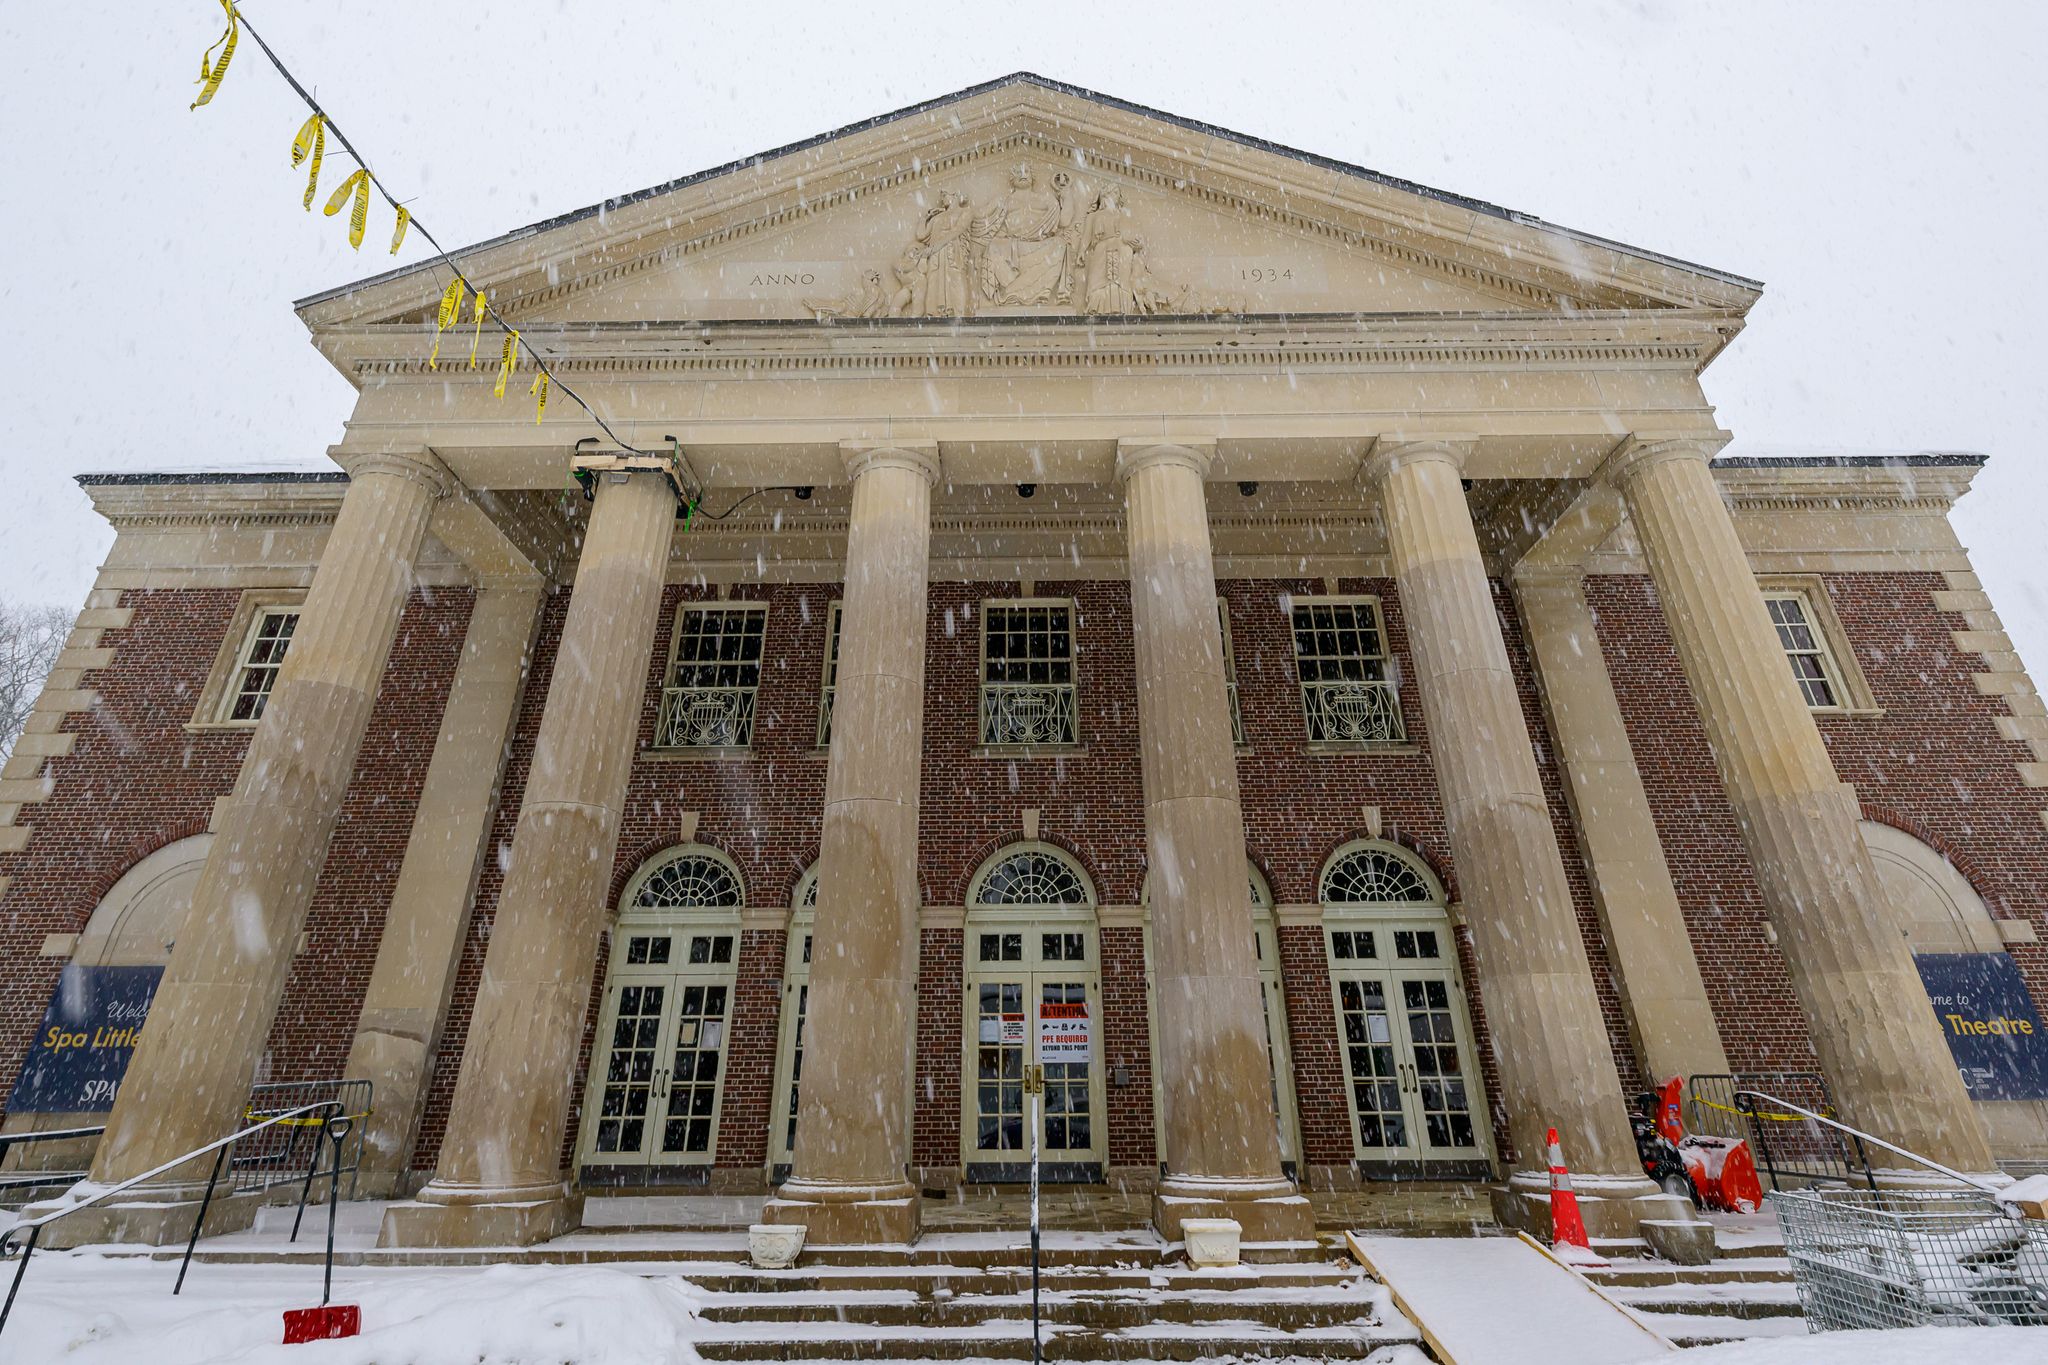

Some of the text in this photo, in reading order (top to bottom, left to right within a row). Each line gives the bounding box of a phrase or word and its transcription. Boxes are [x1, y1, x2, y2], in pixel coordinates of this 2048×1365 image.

[750, 273, 814, 286] ANNO
[1241, 268, 1294, 283] 1934
[1956, 992, 1969, 1005] to
[1042, 1006, 1088, 1017] ATTENTION
[1945, 1014, 2033, 1036] Theatre
[43, 1026, 88, 1054] Spa
[1042, 1035, 1088, 1043] PPE REQUIRED
